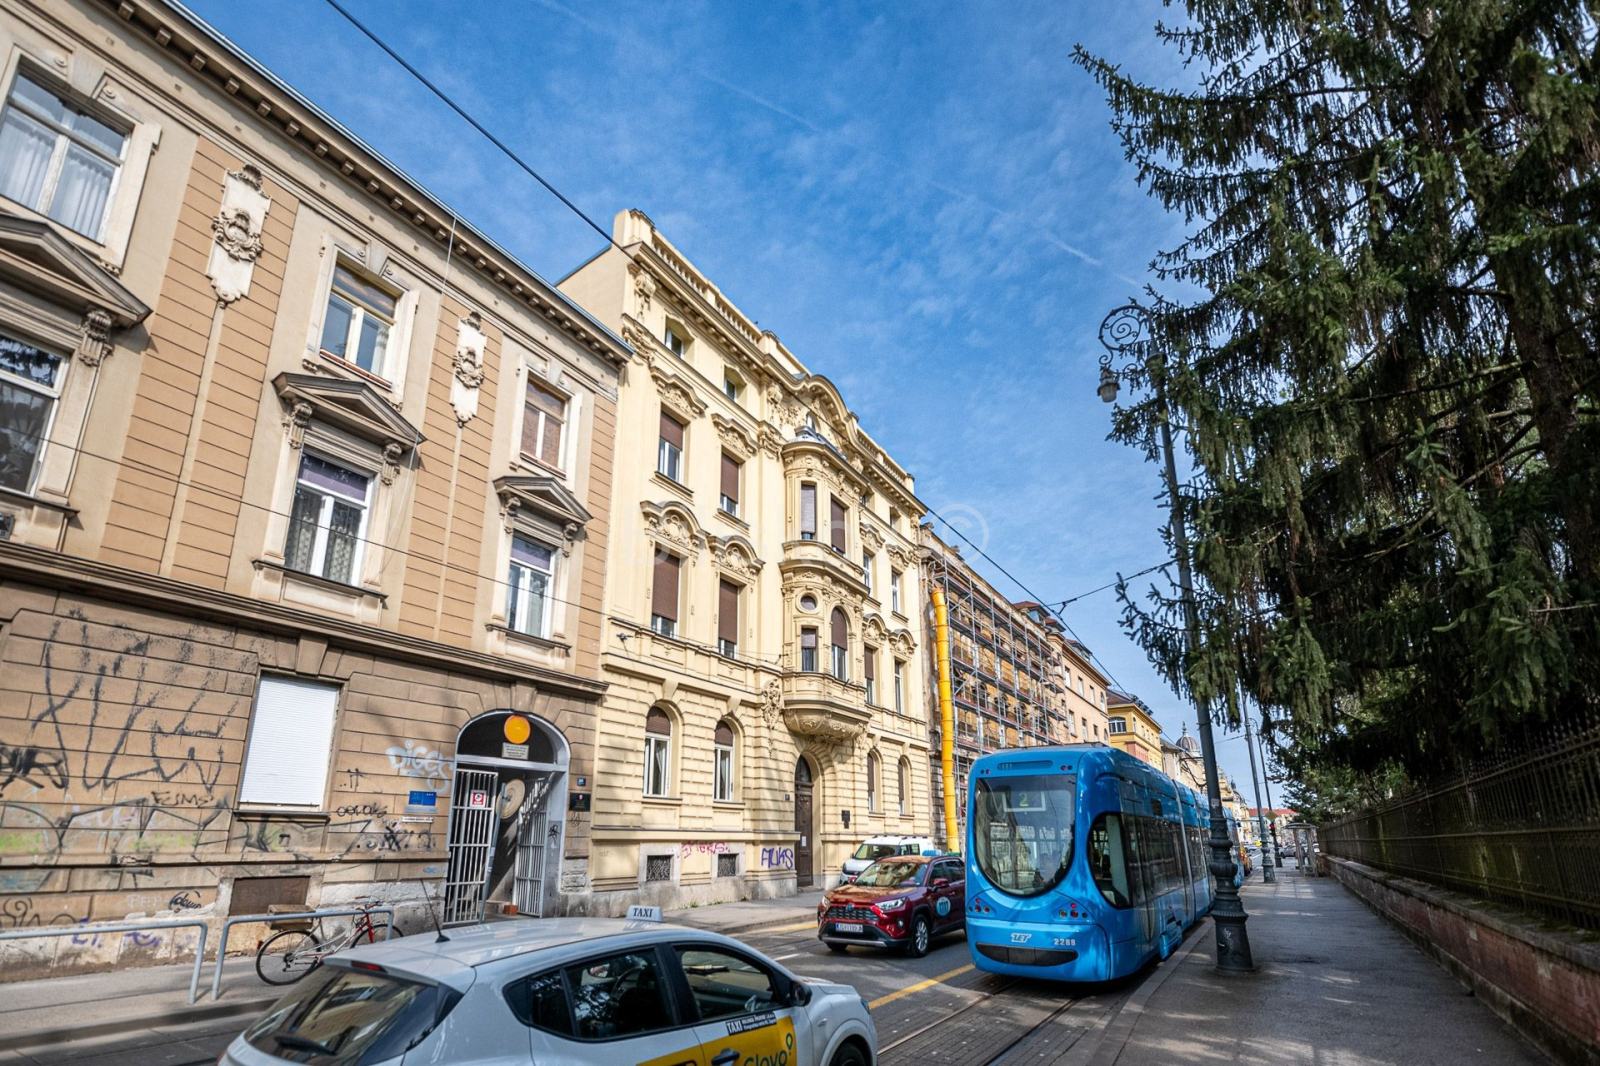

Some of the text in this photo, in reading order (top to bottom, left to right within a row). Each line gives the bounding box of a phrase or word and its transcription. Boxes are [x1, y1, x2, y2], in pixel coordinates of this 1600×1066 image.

[1019, 793, 1029, 807] 2
[633, 907, 653, 918] TAXI
[726, 1019, 743, 1034] TAXI
